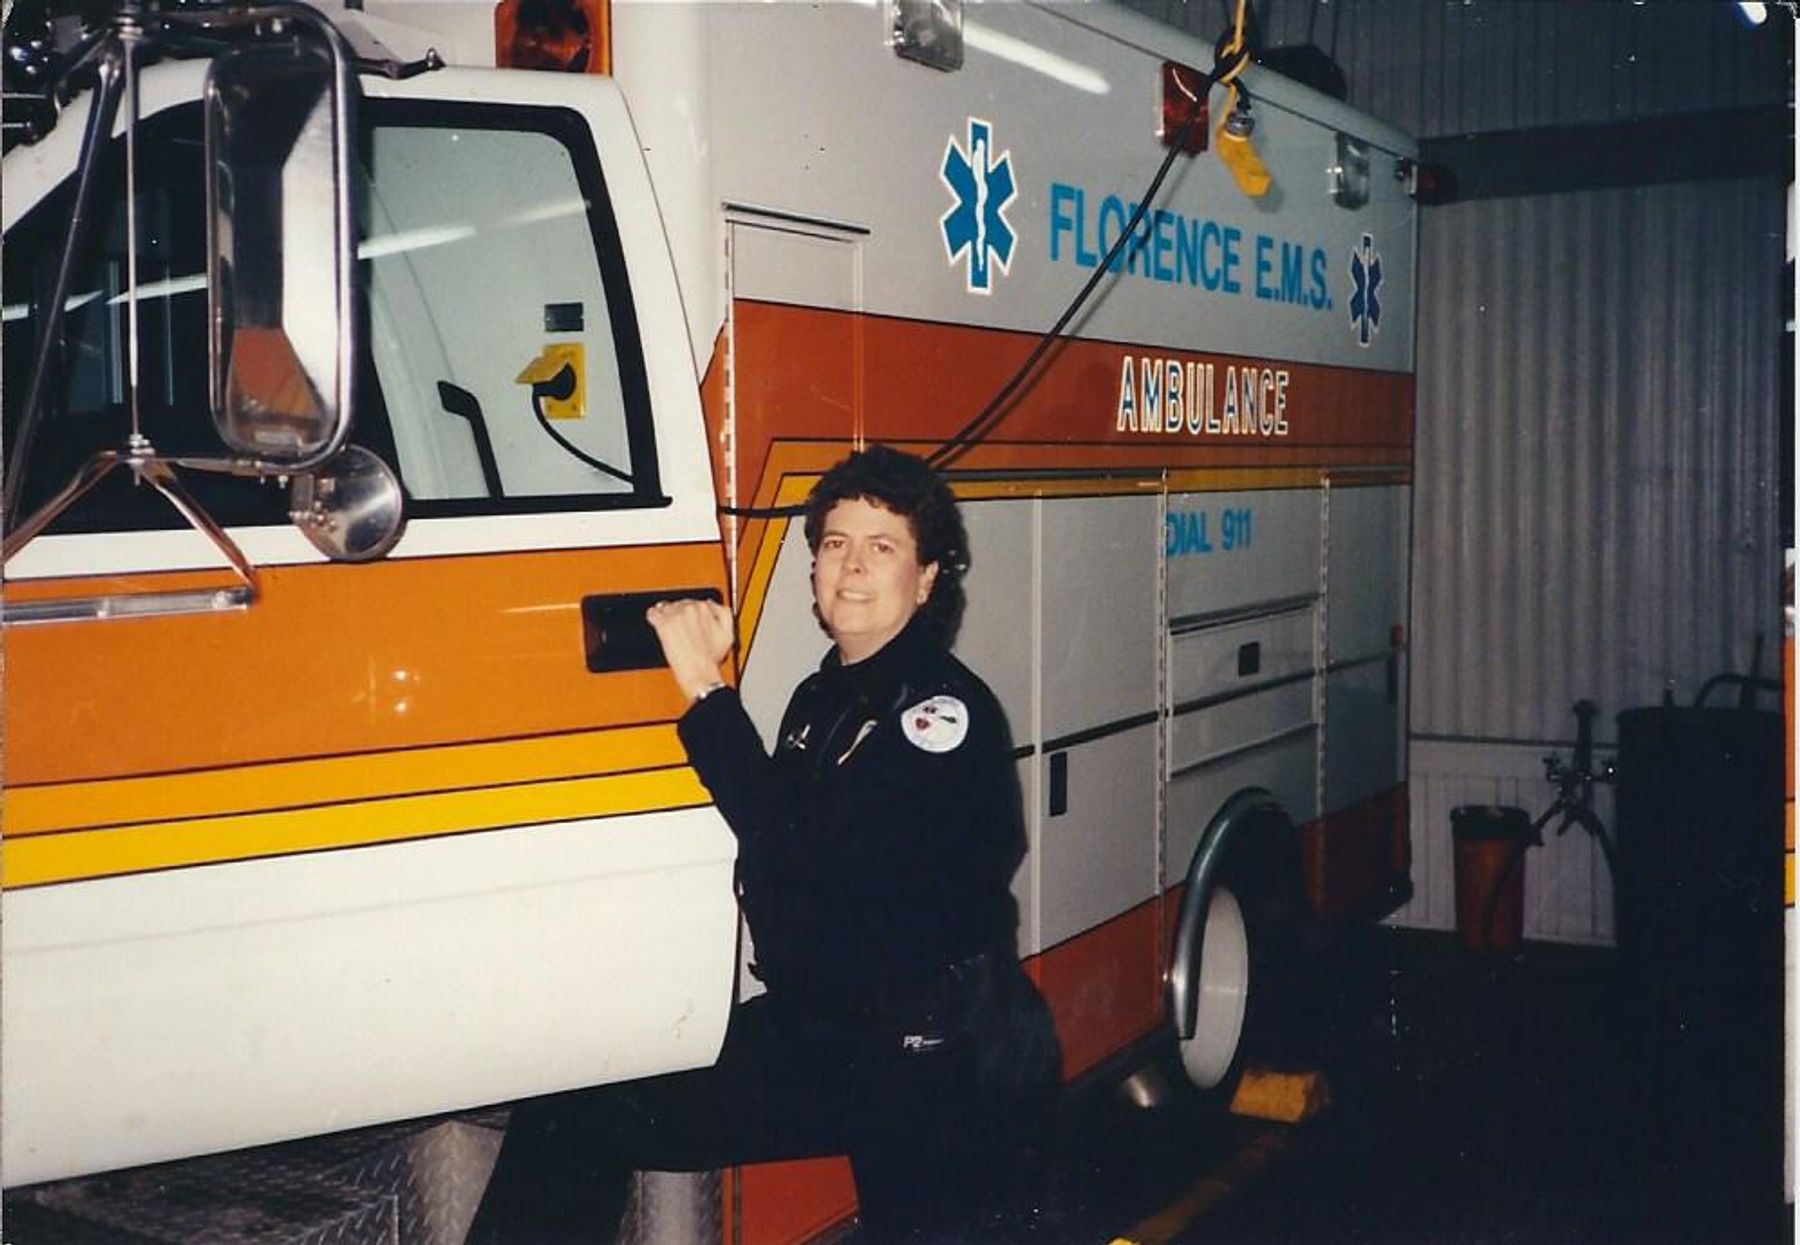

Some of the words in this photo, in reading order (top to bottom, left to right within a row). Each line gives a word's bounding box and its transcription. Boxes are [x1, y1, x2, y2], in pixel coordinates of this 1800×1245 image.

[1050, 182, 1241, 294] FLORENCE
[1255, 234, 1332, 310] E.M.S.
[1116, 355, 1290, 435] AMBULANCE
[1221, 507, 1252, 551] 911
